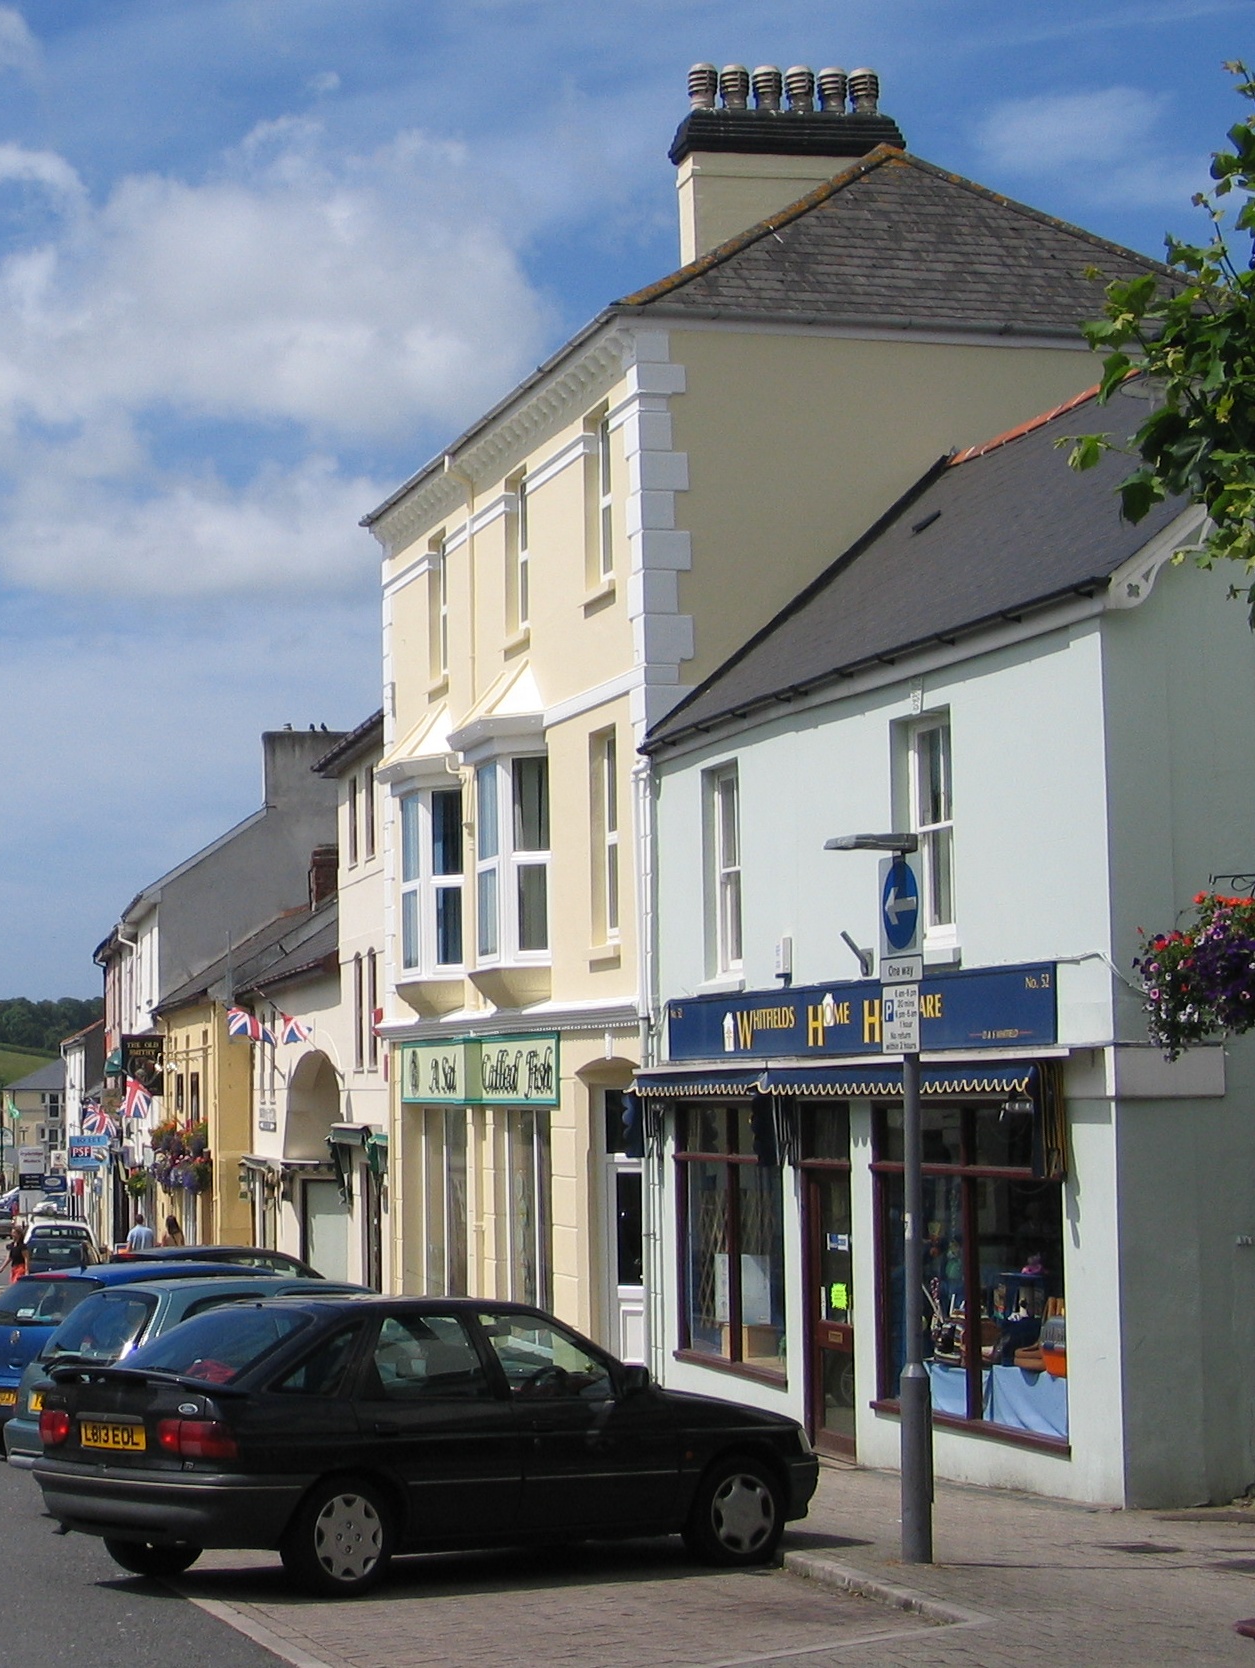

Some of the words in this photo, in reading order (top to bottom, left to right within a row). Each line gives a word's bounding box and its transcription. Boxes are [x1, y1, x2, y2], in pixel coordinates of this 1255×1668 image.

[888, 965, 900, 977] One
[901, 966, 914, 978] way
[886, 1001, 893, 1021] P
[736, 1006, 795, 1049] WHITFIELDS
[807, 1000, 850, 1047] HOME
[524, 1046, 553, 1100] Fish
[72, 1146, 90, 1157] PSF
[84, 1423, 109, 1444] L813
